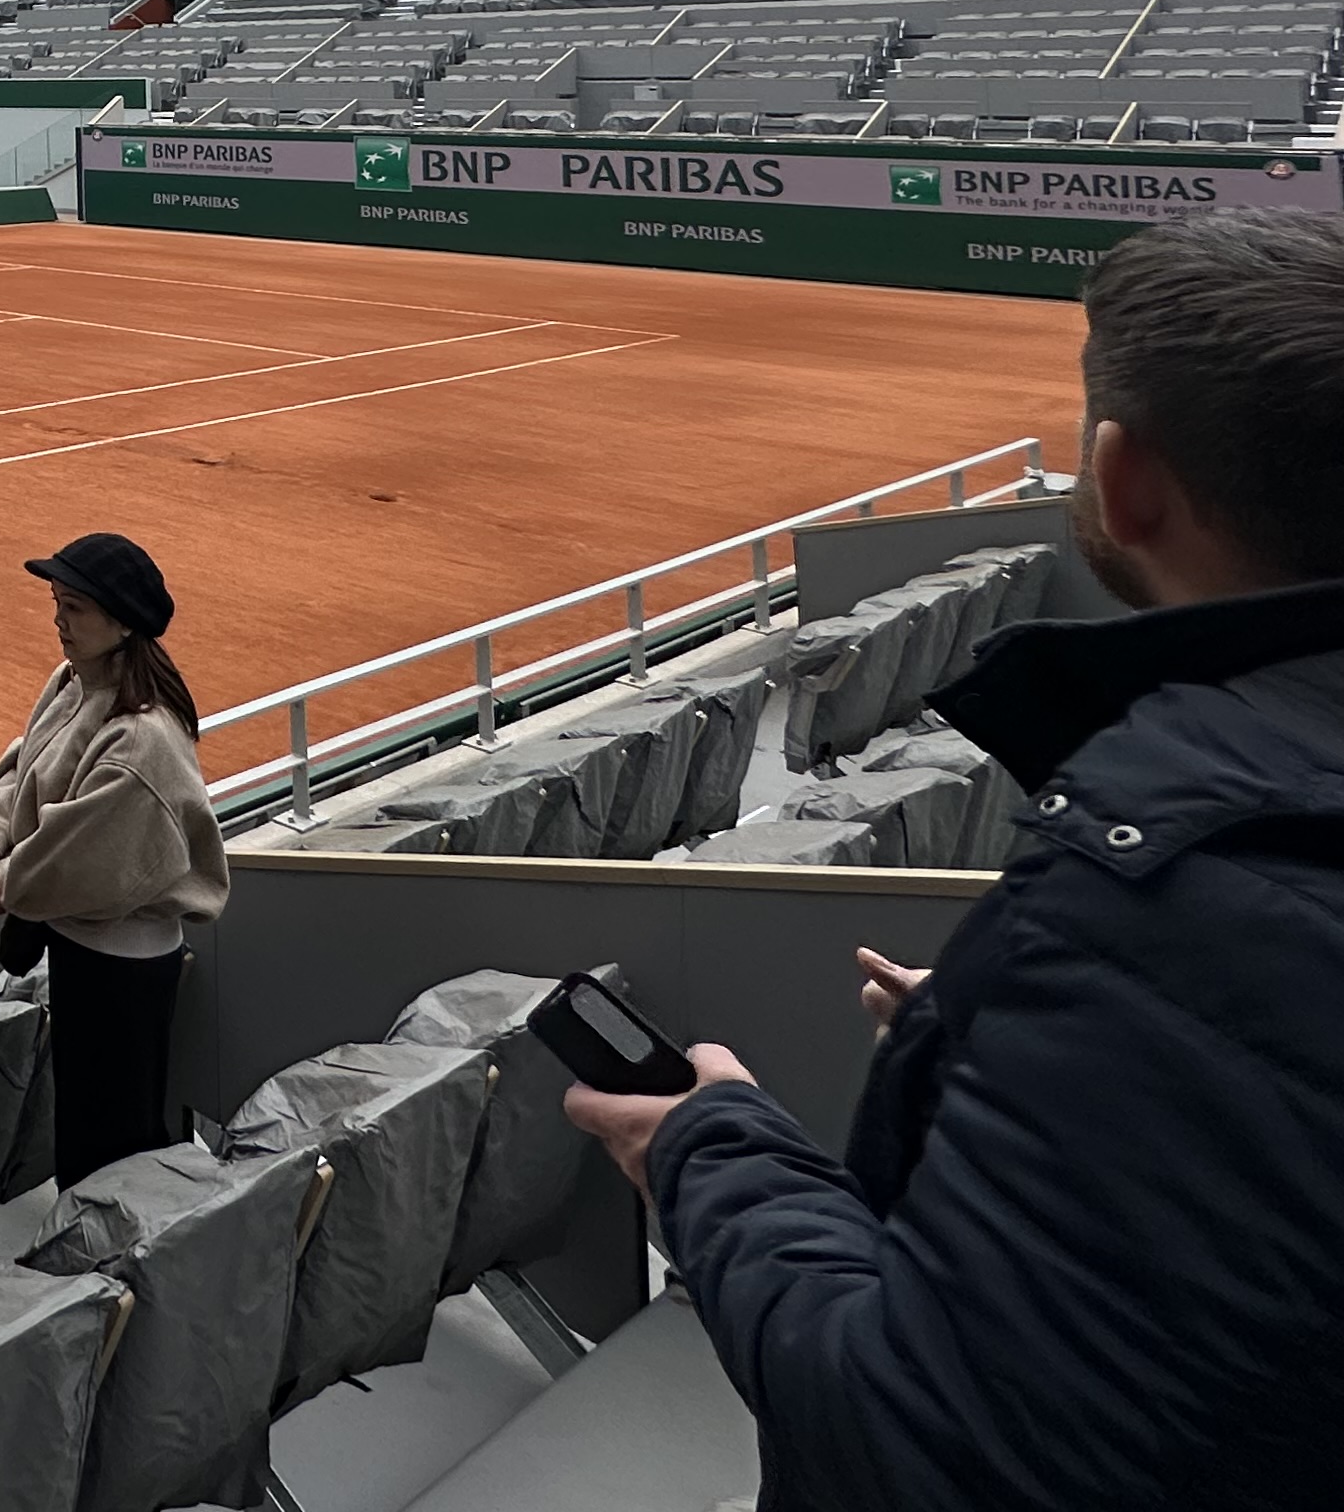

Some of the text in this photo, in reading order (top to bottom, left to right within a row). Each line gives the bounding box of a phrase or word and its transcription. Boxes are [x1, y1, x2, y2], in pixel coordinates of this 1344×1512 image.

[152, 143, 272, 163] BNP PARIBAS
[422, 149, 784, 198] BNP PARIBAS
[954, 169, 1217, 201] BNP PARIBAS
[153, 192, 239, 209] BNP PARIBAS
[955, 195, 983, 206] The
[989, 196, 1027, 207] bank
[1033, 198, 1056, 210] for
[1063, 202, 1072, 210] a
[1078, 200, 1156, 216] changing
[360, 205, 469, 225] BNP PARIBAS
[624, 220, 764, 244] BNP PARIBAS
[968, 243, 1023, 261] BNP
